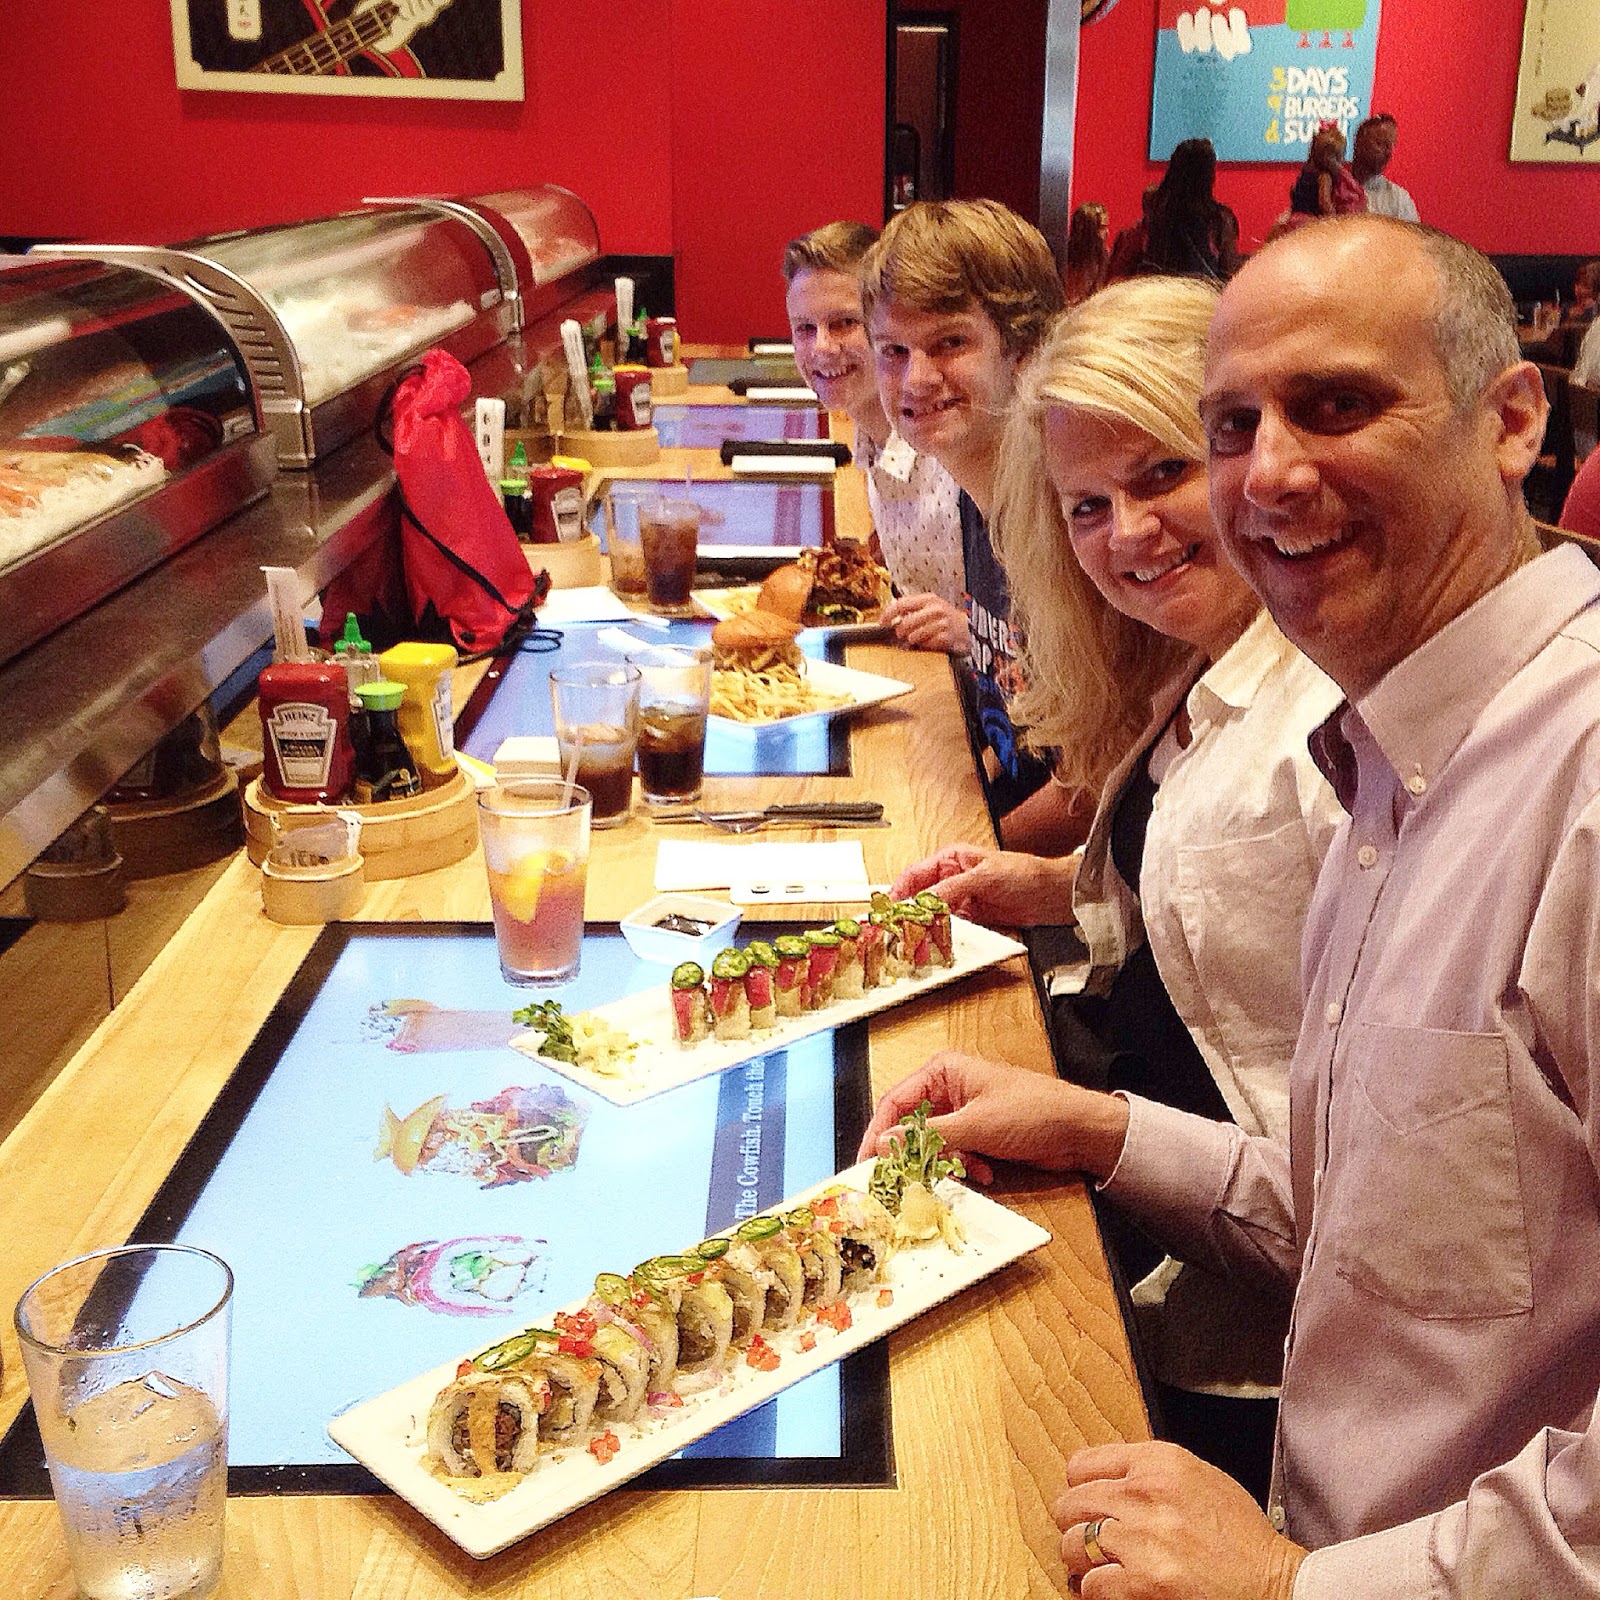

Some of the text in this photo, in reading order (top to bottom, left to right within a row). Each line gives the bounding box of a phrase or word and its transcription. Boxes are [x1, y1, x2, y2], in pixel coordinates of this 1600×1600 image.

[1270, 65, 1349, 95] 3 DAYS
[1285, 96, 1360, 119] BURGERS
[742, 1082, 764, 1123] Touch
[737, 1125, 761, 1187] Cowfish.
[735, 1189, 758, 1219] The
